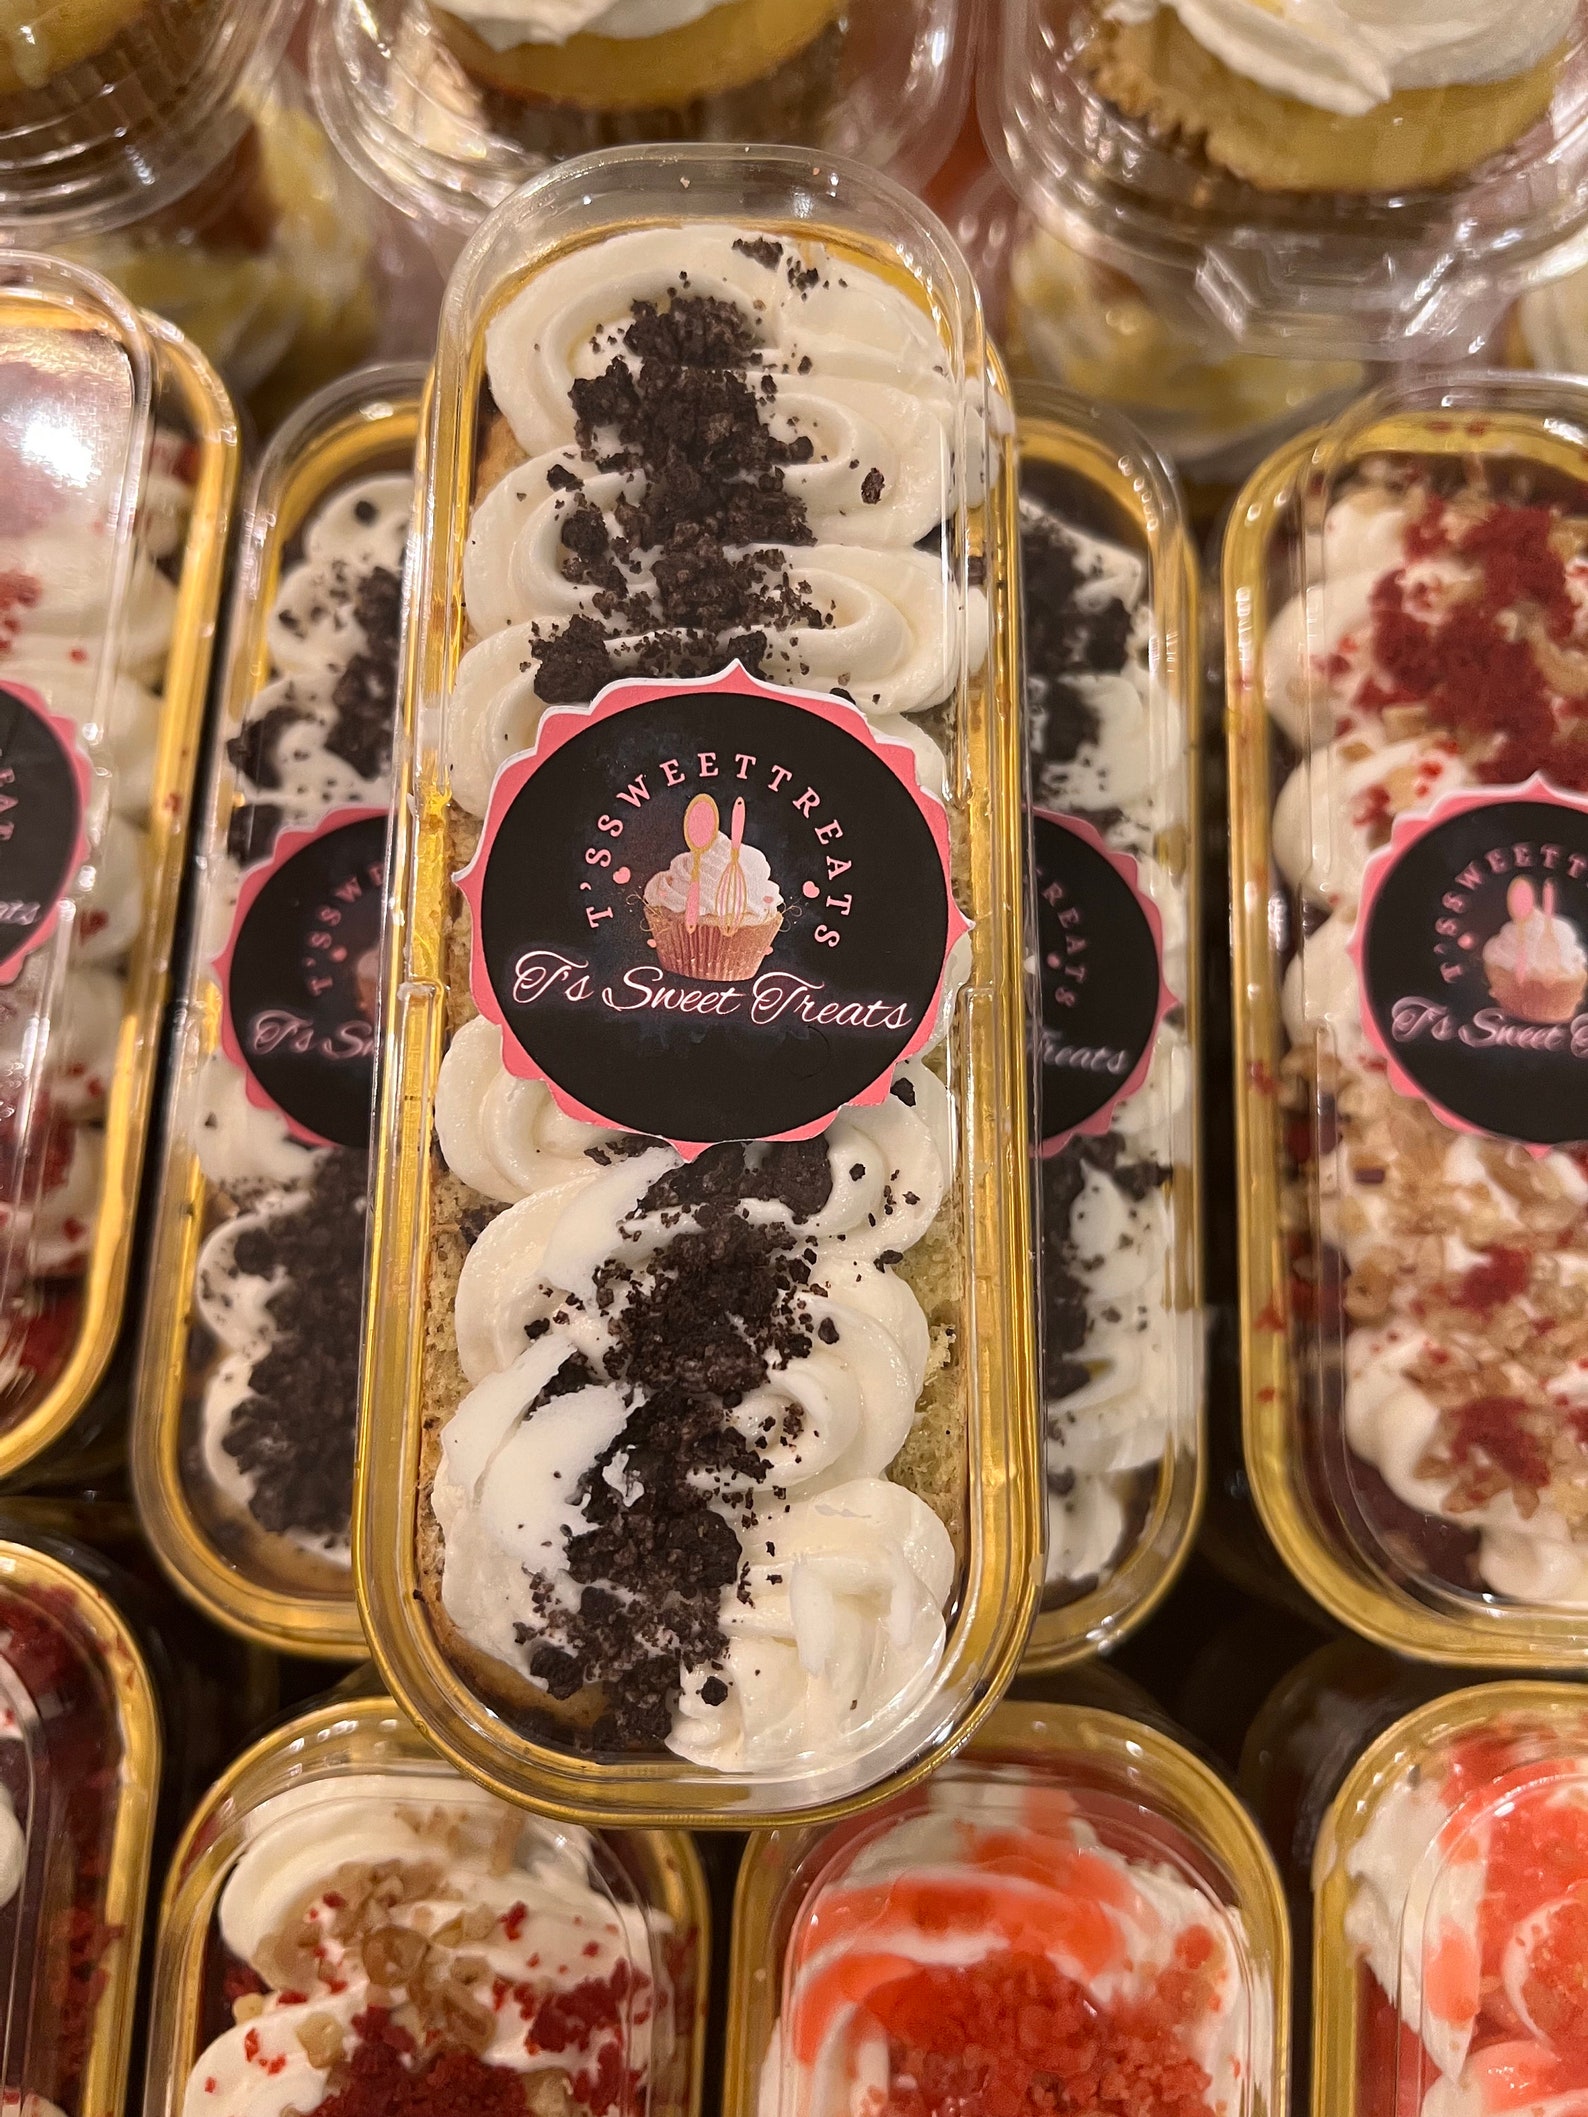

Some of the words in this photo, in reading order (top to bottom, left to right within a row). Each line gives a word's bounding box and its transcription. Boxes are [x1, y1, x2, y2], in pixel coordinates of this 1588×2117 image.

[512, 949, 595, 1004] T's
[601, 965, 747, 1016] Sweet
[750, 970, 913, 1031] Treats
